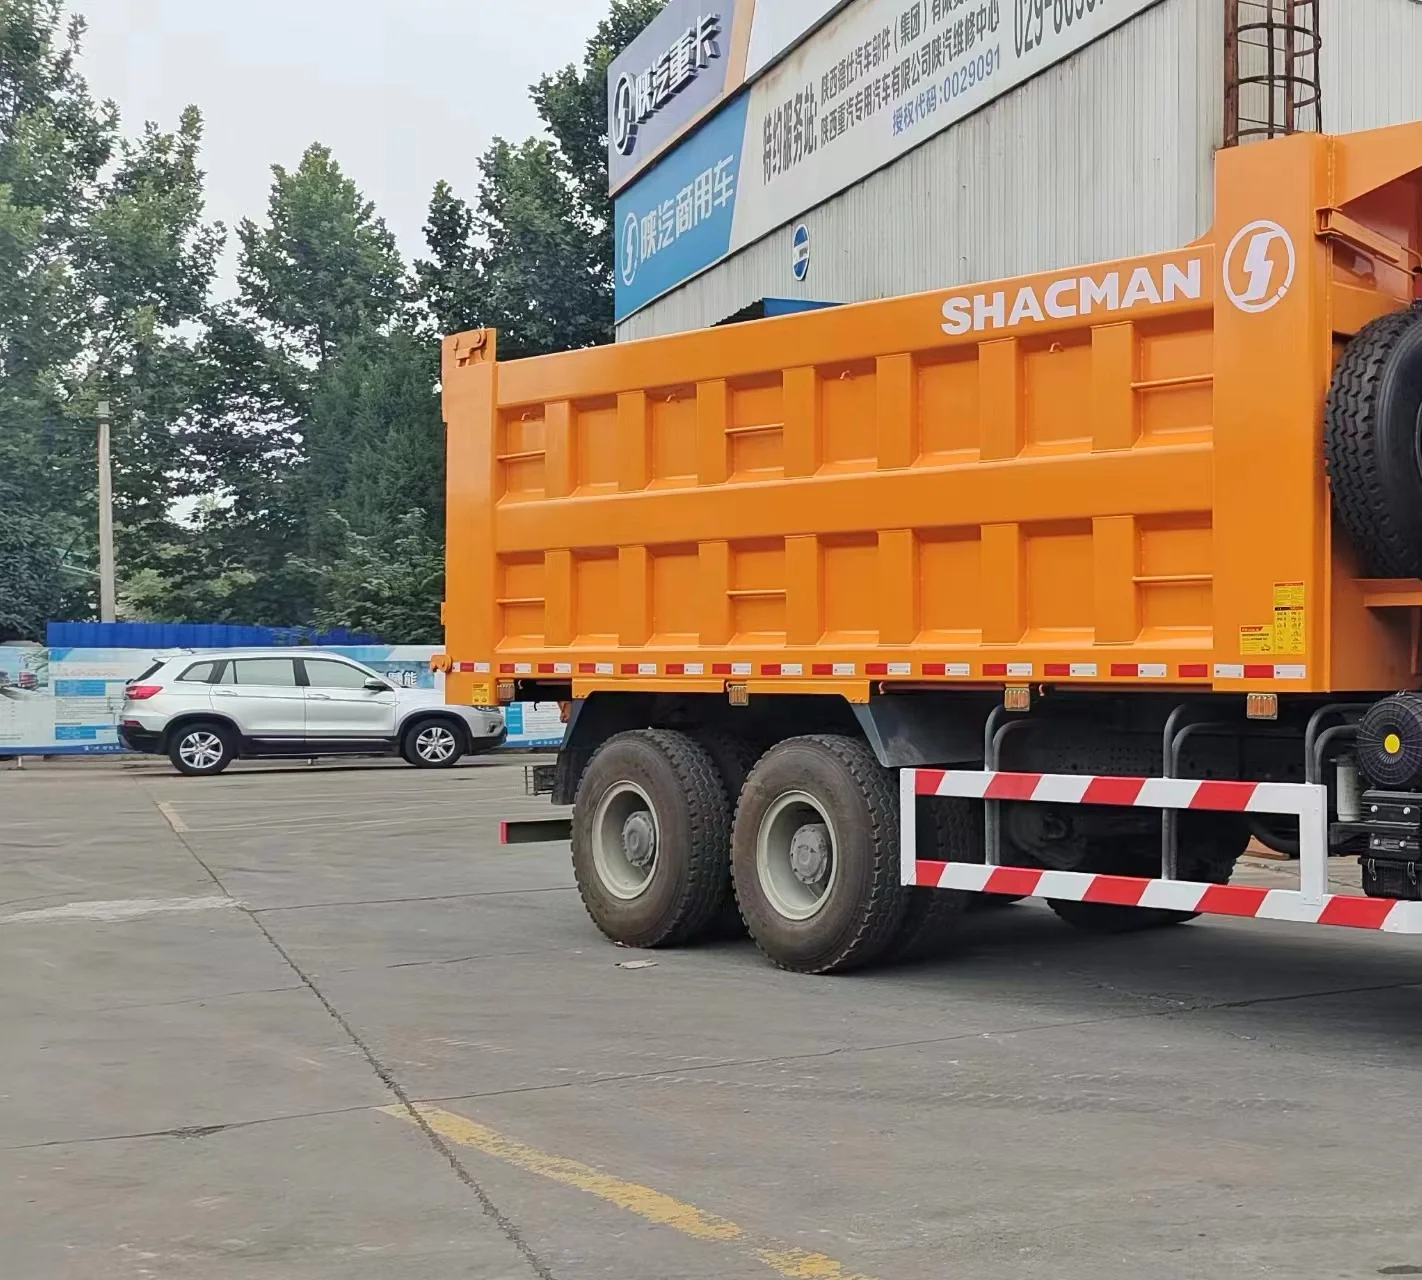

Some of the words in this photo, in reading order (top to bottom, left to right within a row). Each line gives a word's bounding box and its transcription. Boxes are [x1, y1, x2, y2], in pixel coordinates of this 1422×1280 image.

[635, 13, 721, 123] 陕汽重卡
[640, 154, 734, 263] 陕汽商用车
[941, 259, 1201, 335] SHACMAN
